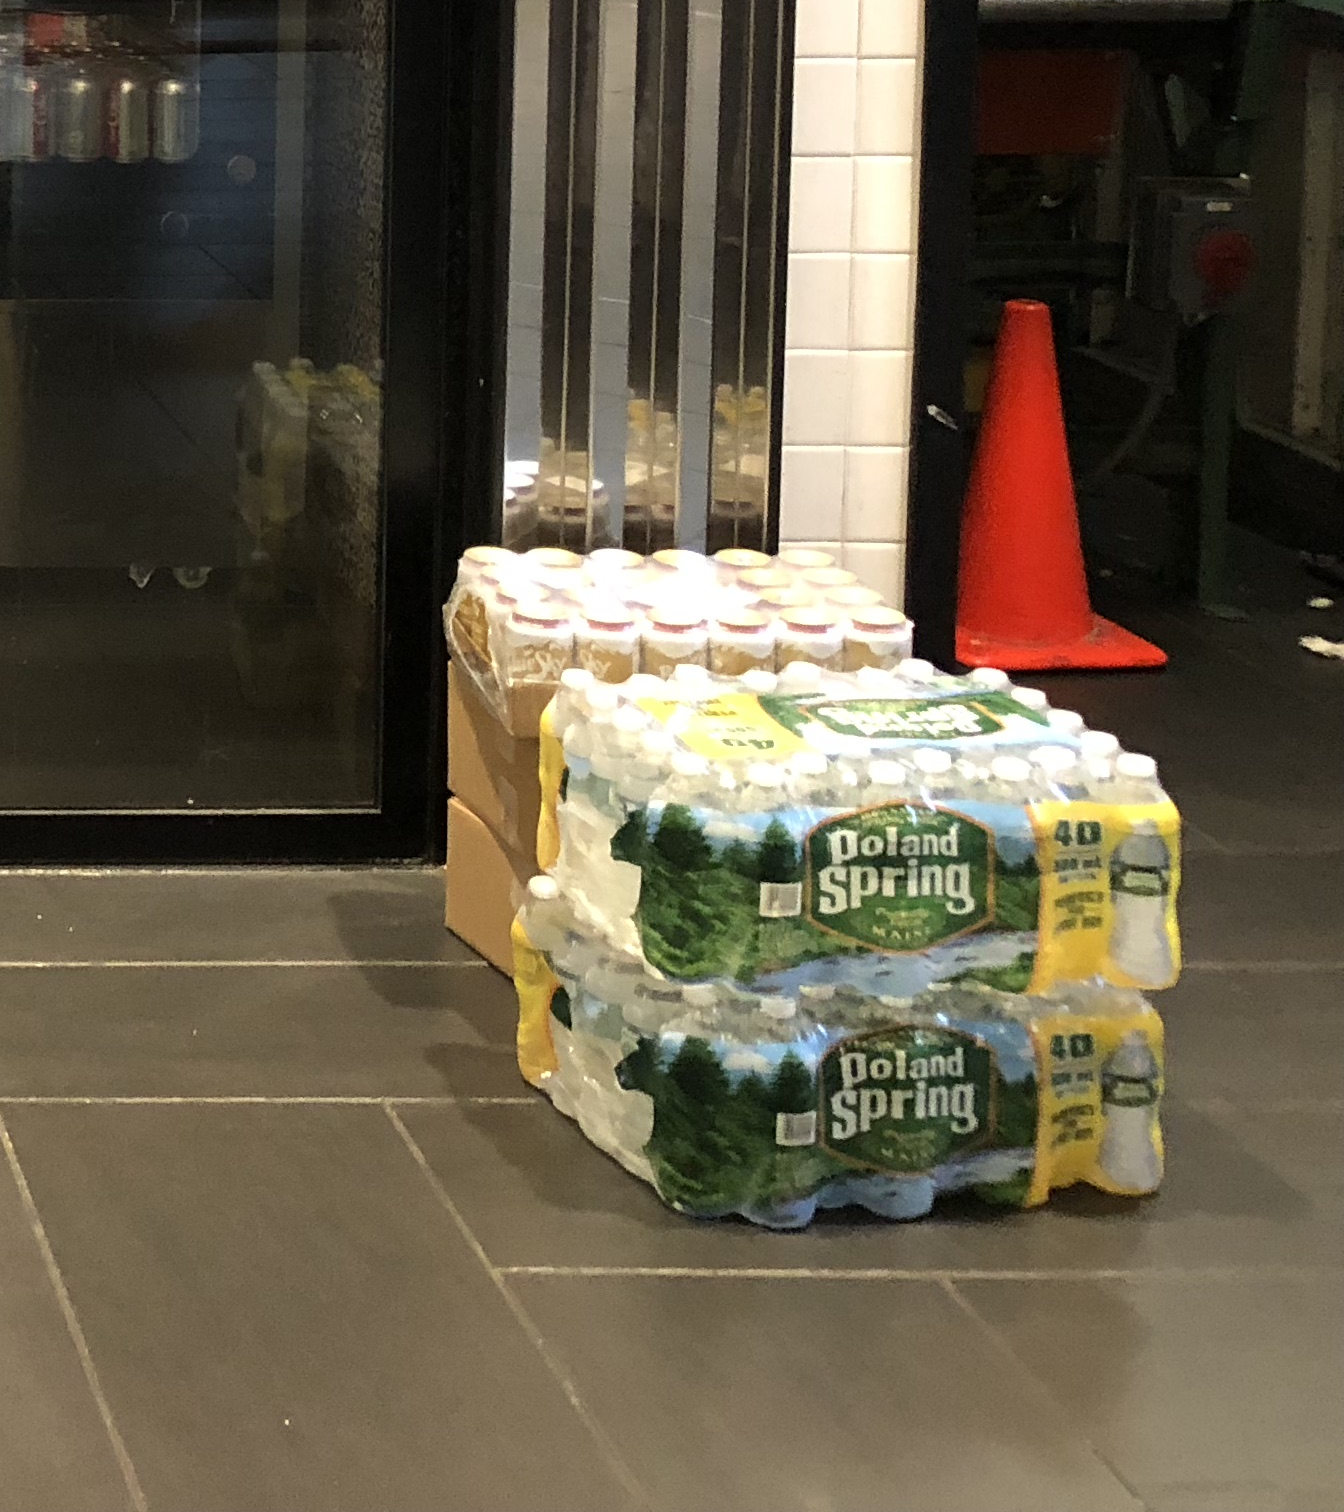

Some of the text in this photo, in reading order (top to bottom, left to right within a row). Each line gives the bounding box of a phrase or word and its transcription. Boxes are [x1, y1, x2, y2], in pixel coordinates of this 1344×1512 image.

[826, 823, 961, 864] Poland
[1055, 819, 1103, 847] 40
[818, 858, 976, 915] Spring
[839, 1046, 964, 1089] Poland
[830, 1080, 979, 1140] Spring
